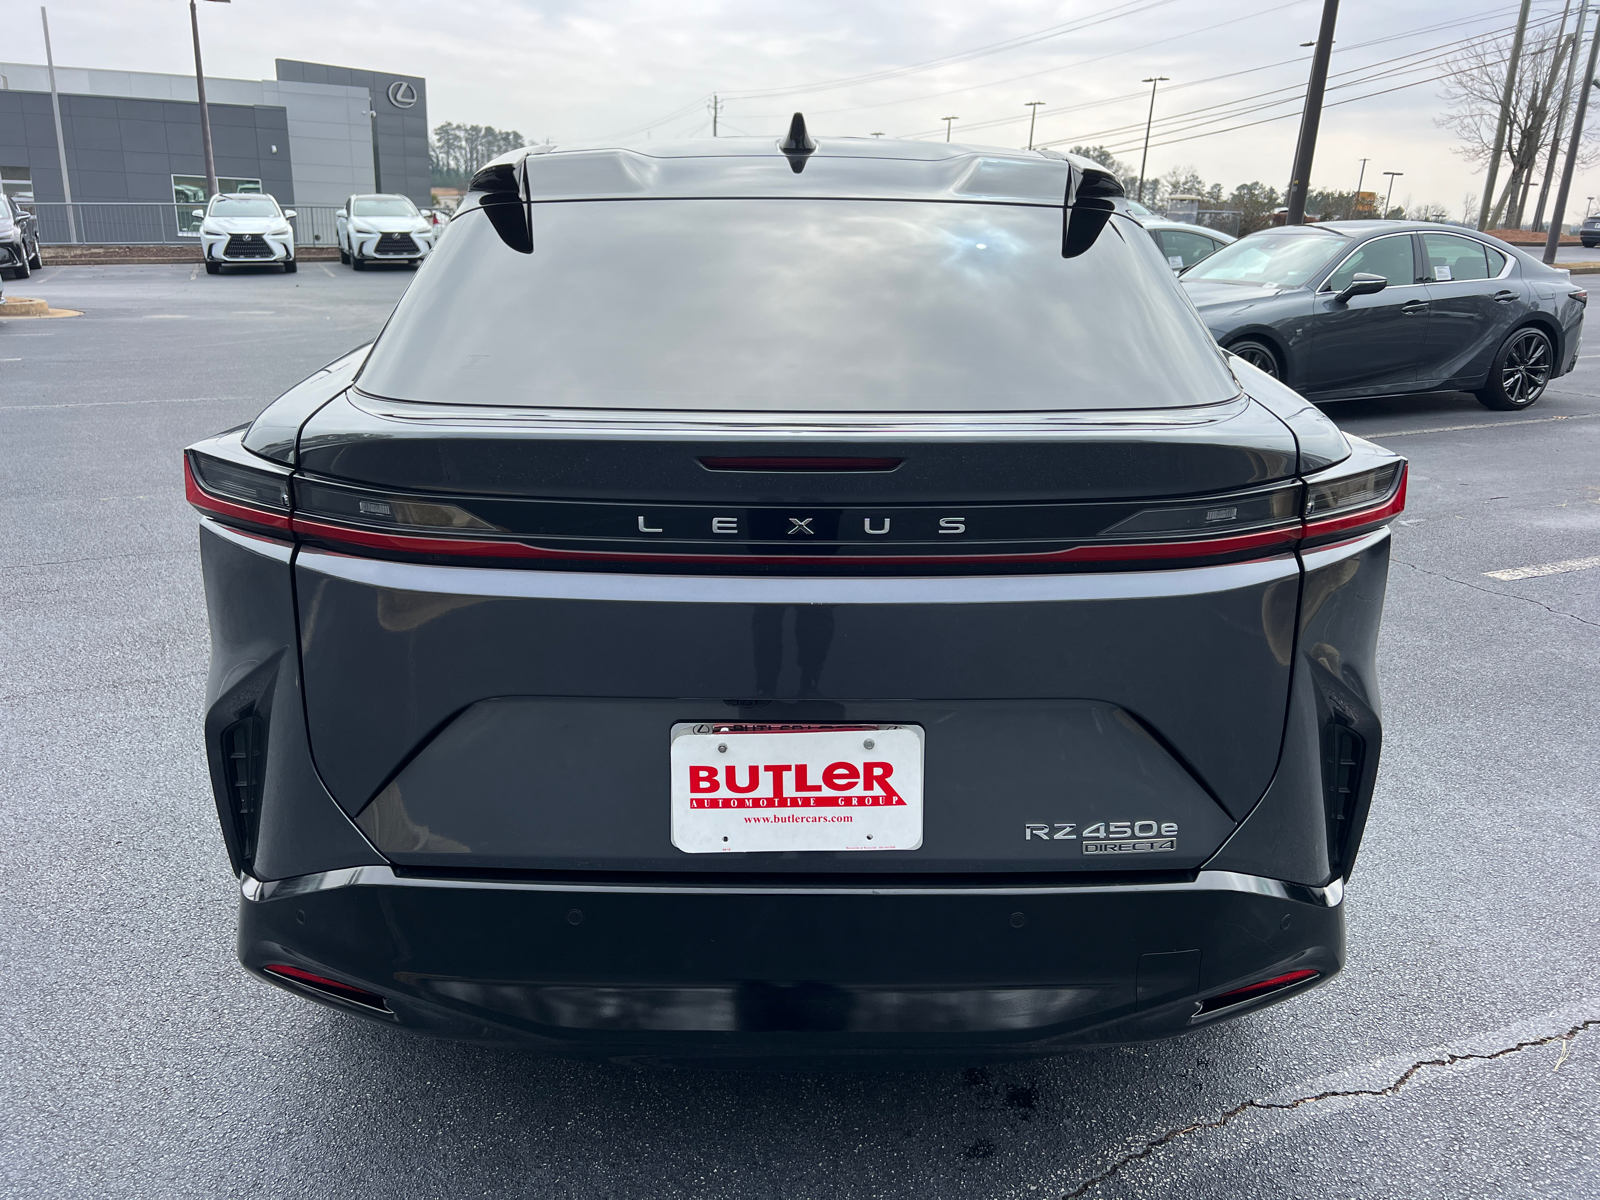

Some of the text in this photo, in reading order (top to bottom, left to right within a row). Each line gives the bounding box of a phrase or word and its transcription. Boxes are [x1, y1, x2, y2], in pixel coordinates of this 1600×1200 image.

[638, 516, 966, 535] LEXUS
[691, 796, 899, 807] AUTOMOTIVE GROUP
[744, 814, 853, 824] www.butlercars.com
[1025, 820, 1178, 840] RZ 450e
[1084, 840, 1175, 853] DIRECT4
